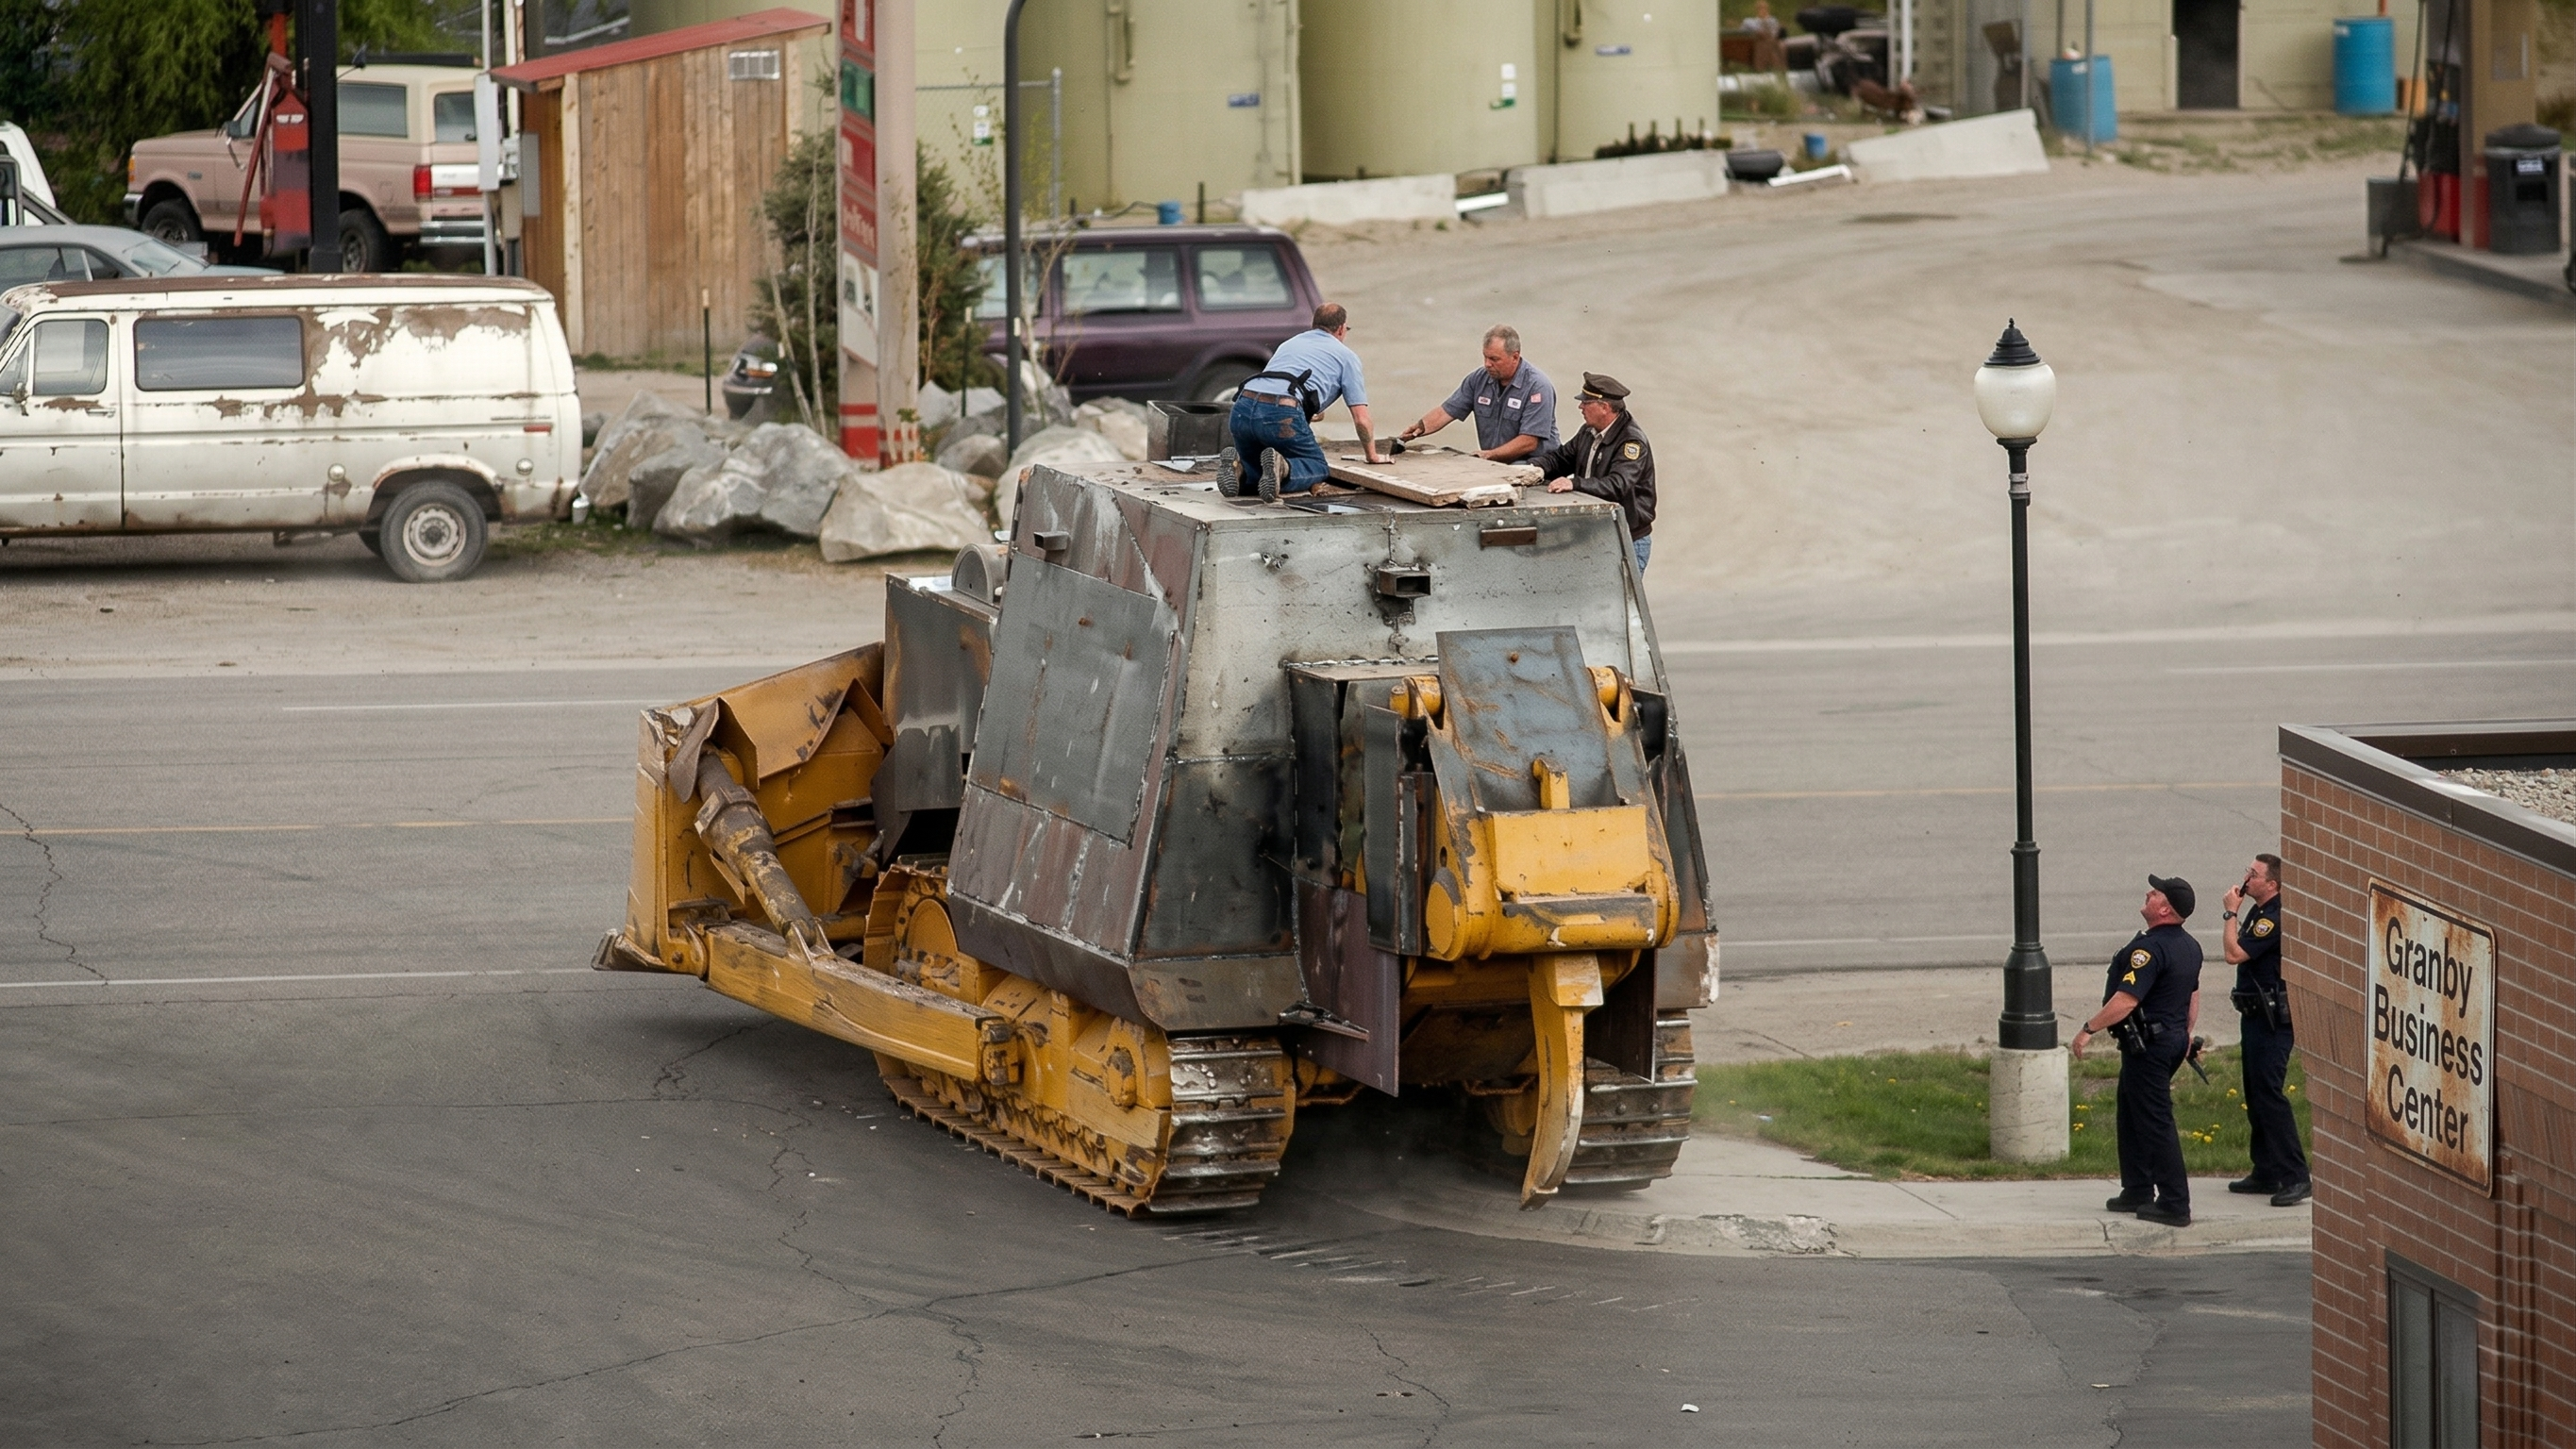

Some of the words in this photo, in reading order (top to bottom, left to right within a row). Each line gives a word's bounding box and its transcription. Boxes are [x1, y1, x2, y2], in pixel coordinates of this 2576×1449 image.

[2385, 916, 2473, 1019] Granby
[2374, 983, 2484, 1087] Business
[2386, 1064, 2469, 1155] Center
